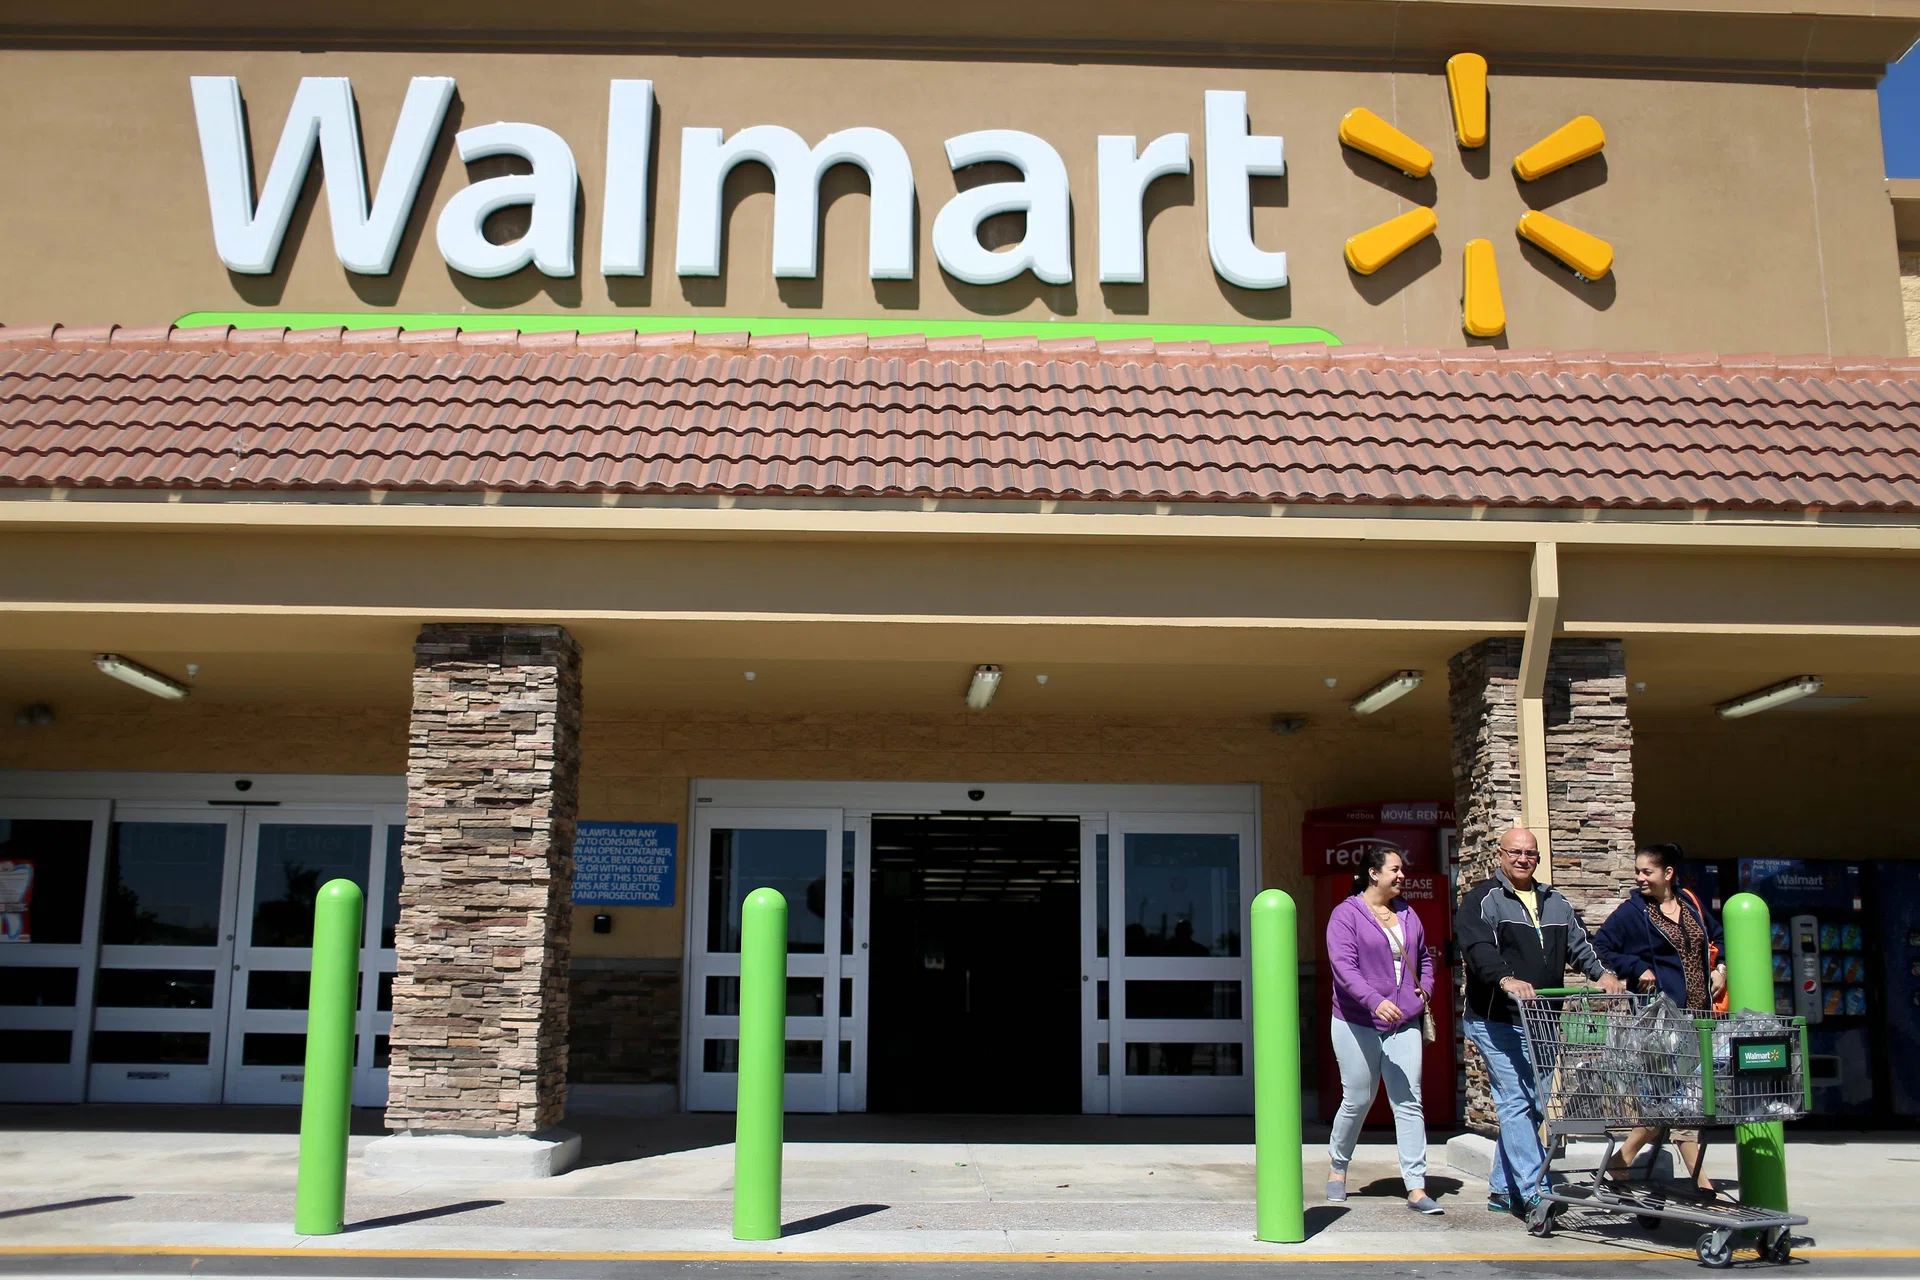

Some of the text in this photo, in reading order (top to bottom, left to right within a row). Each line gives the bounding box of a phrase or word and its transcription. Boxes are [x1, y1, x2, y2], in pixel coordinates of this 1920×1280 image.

[189, 75, 1289, 290] Walmart
[1346, 810, 1456, 820] redbox MOVIE RENTAL
[576, 828, 656, 838] NLAWFUL FOR ANY
[586, 837, 598, 846] TO
[644, 839, 658, 847] OR
[584, 846, 596, 854] AN
[598, 846, 622, 855] OPEN
[622, 847, 672, 856] CONTAINER,
[1325, 844, 1411, 866] redx
[611, 856, 654, 865] BEVERAGE
[656, 857, 665, 865] IN
[586, 864, 599, 872] OR
[599, 864, 630, 873] WITHIN
[633, 865, 647, 873] 100
[648, 865, 669, 874] FEET
[577, 873, 598, 881] PART
[599, 873, 611, 881] OF
[612, 874, 631, 882] THIS
[1777, 874, 1823, 885] Walmart
[594, 882, 610, 890] ARE
[611, 882, 648, 891] SUBJECT
[648, 883, 660, 891] TO
[577, 891, 597, 899] AND
[598, 891, 660, 901] PROSECUTION.
[1401, 891, 1433, 900] games
[1744, 1052, 1770, 1060] Walmart
